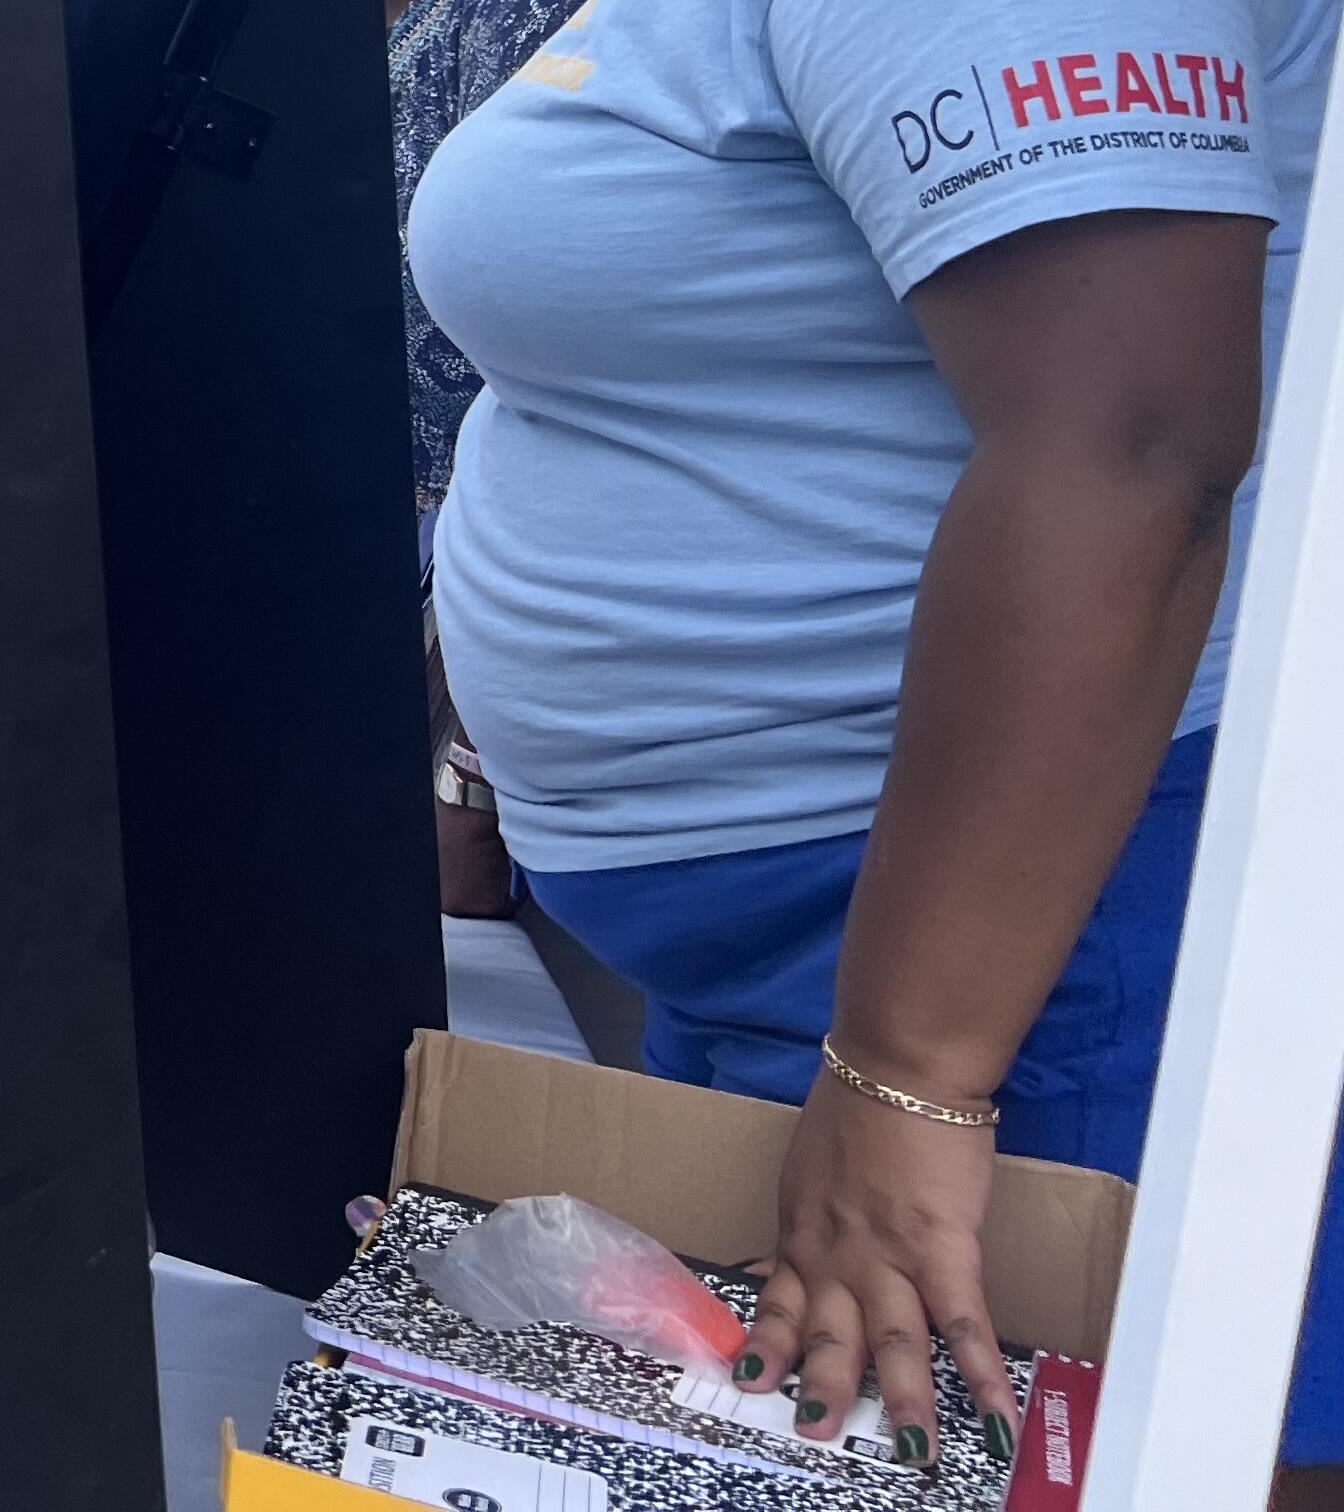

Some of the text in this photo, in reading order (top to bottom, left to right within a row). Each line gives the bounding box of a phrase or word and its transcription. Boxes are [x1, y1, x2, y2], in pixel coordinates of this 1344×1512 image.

[891, 52, 1249, 174] DC HEALTH
[918, 153, 1013, 208] GOVERNMENT
[1019, 144, 1044, 165] OF
[1047, 136, 1088, 158] THE
[1089, 131, 1166, 152] DISTRICT
[1169, 132, 1189, 149] OF
